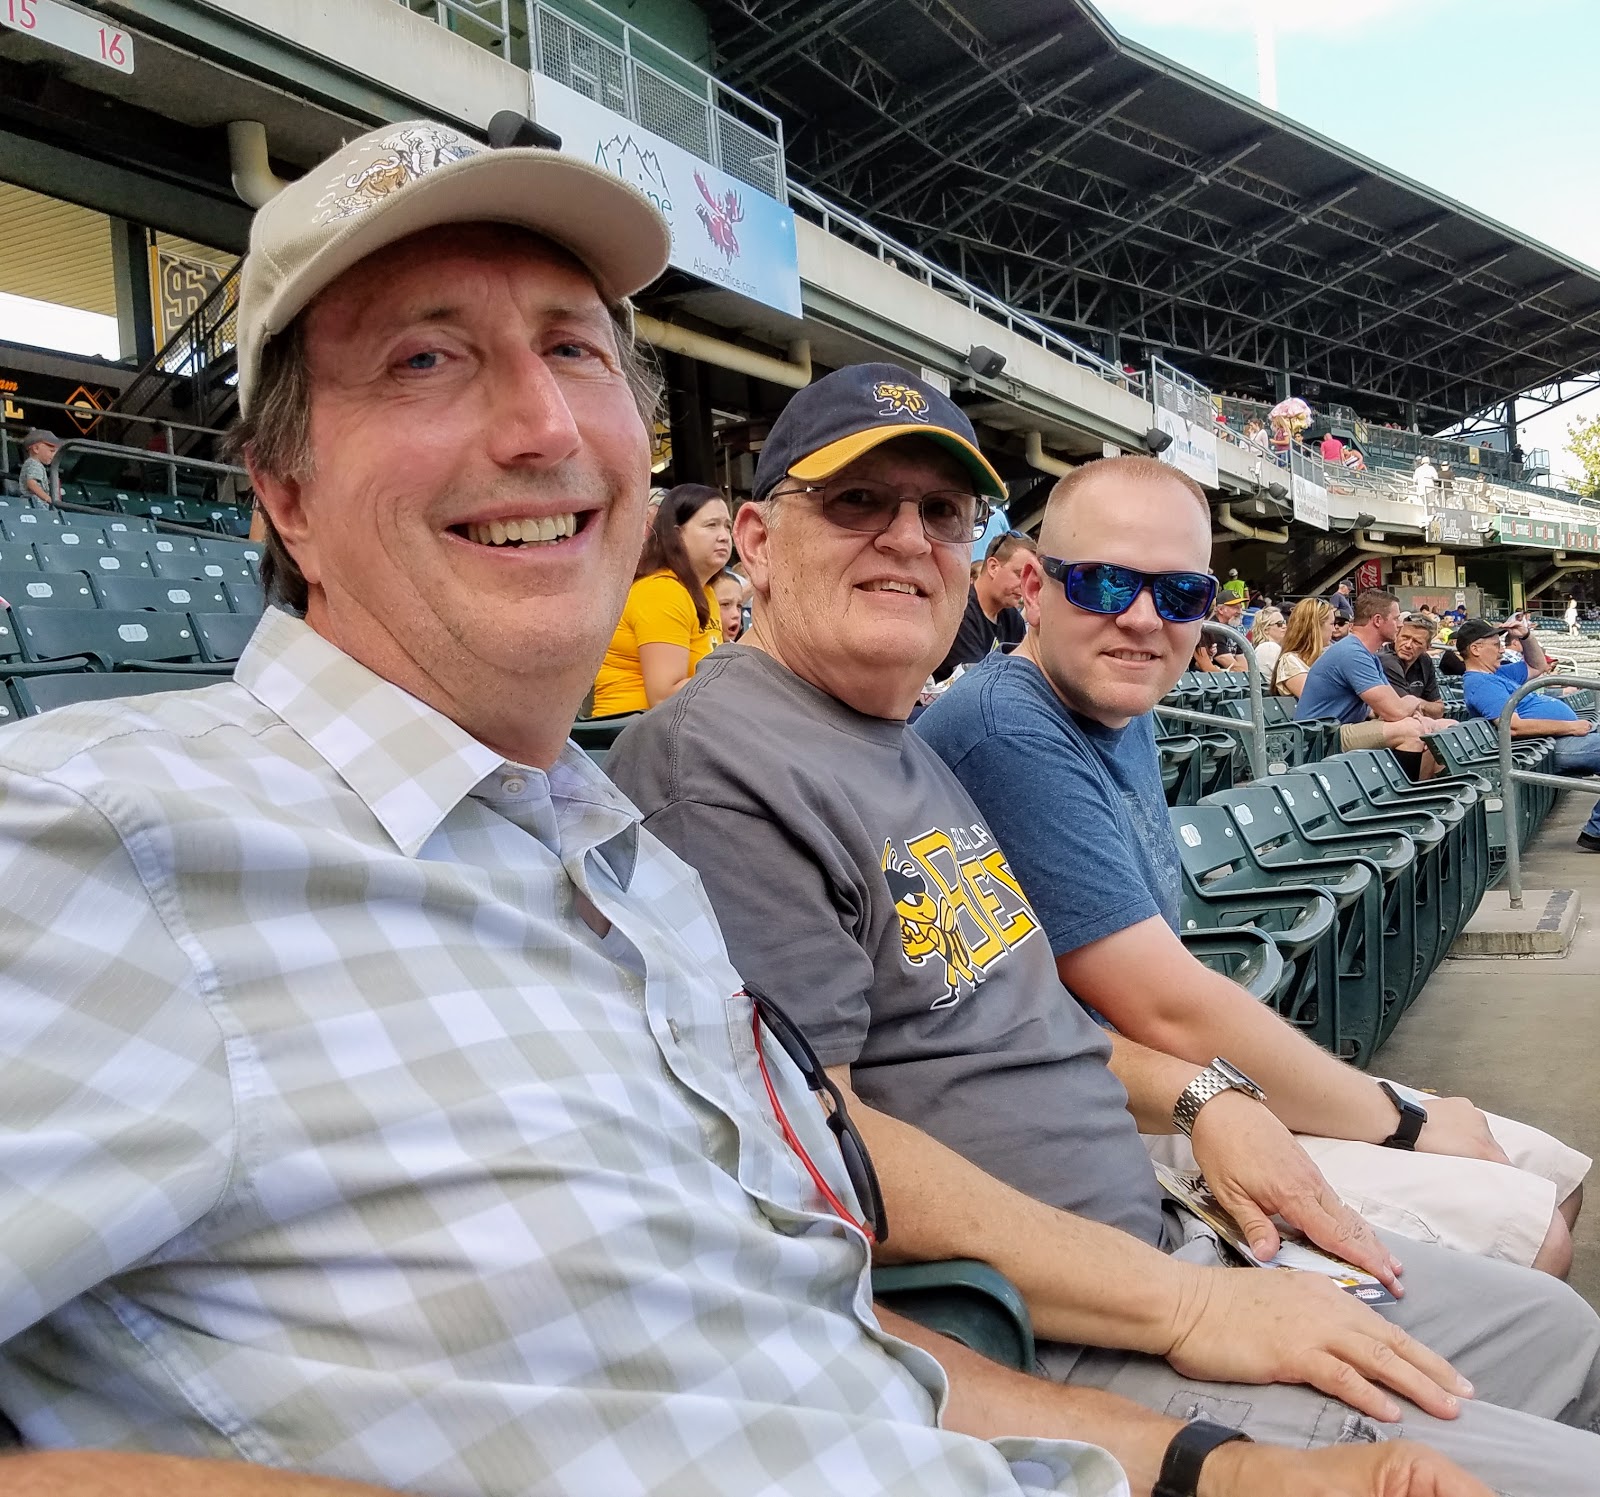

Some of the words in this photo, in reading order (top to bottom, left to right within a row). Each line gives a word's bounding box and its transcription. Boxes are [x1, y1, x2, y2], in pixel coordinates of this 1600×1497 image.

[8, 0, 37, 29] 15
[98, 28, 126, 66] 16
[693, 257, 758, 296] AlpineOffice.com
